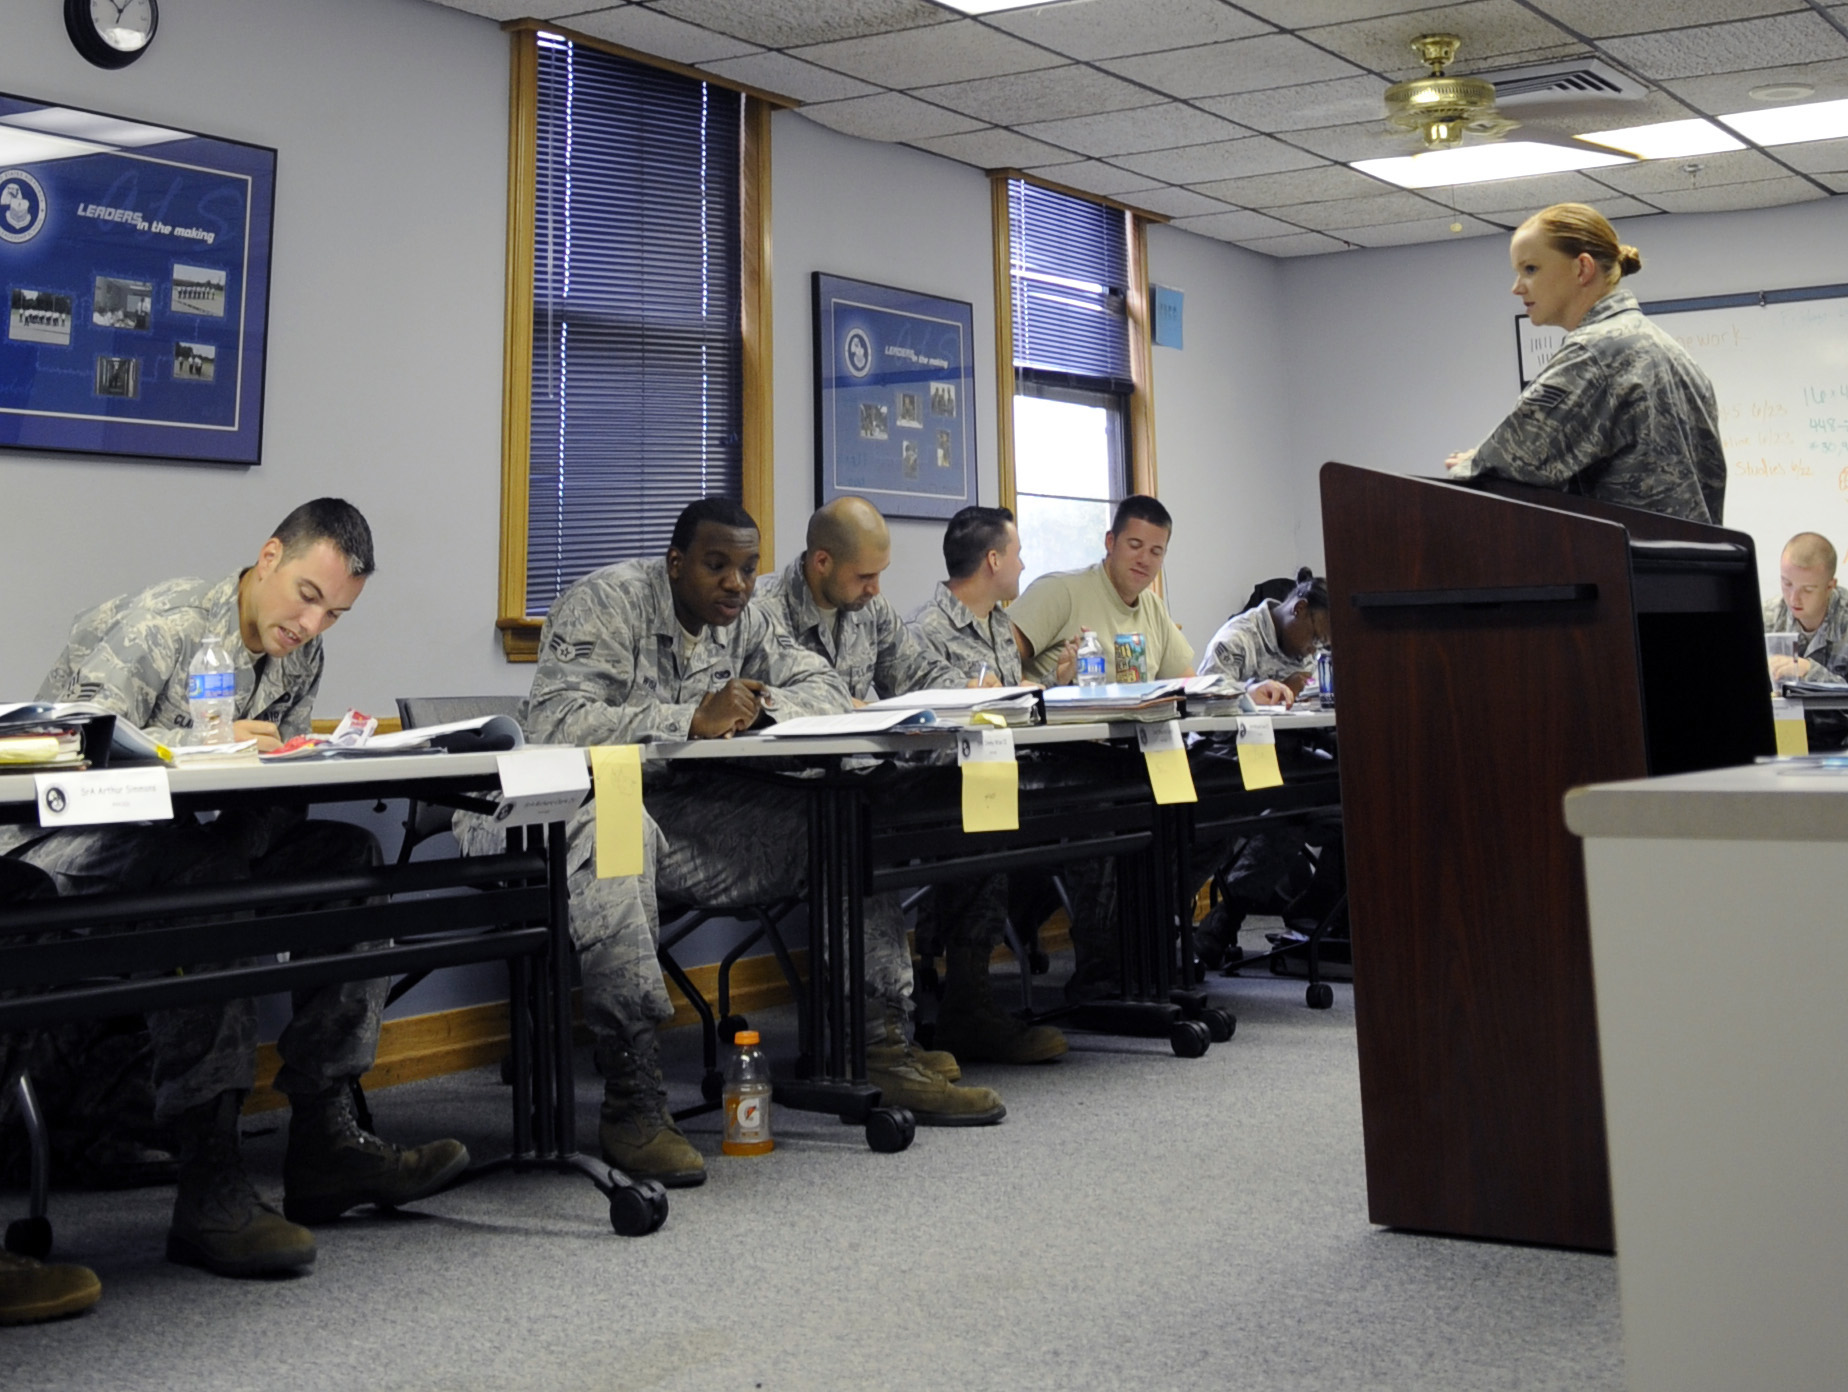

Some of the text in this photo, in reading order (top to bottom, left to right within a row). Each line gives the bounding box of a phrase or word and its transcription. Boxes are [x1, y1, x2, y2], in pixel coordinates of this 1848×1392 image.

[77, 203, 143, 225] LEADERS
[136, 220, 215, 244] in the making
